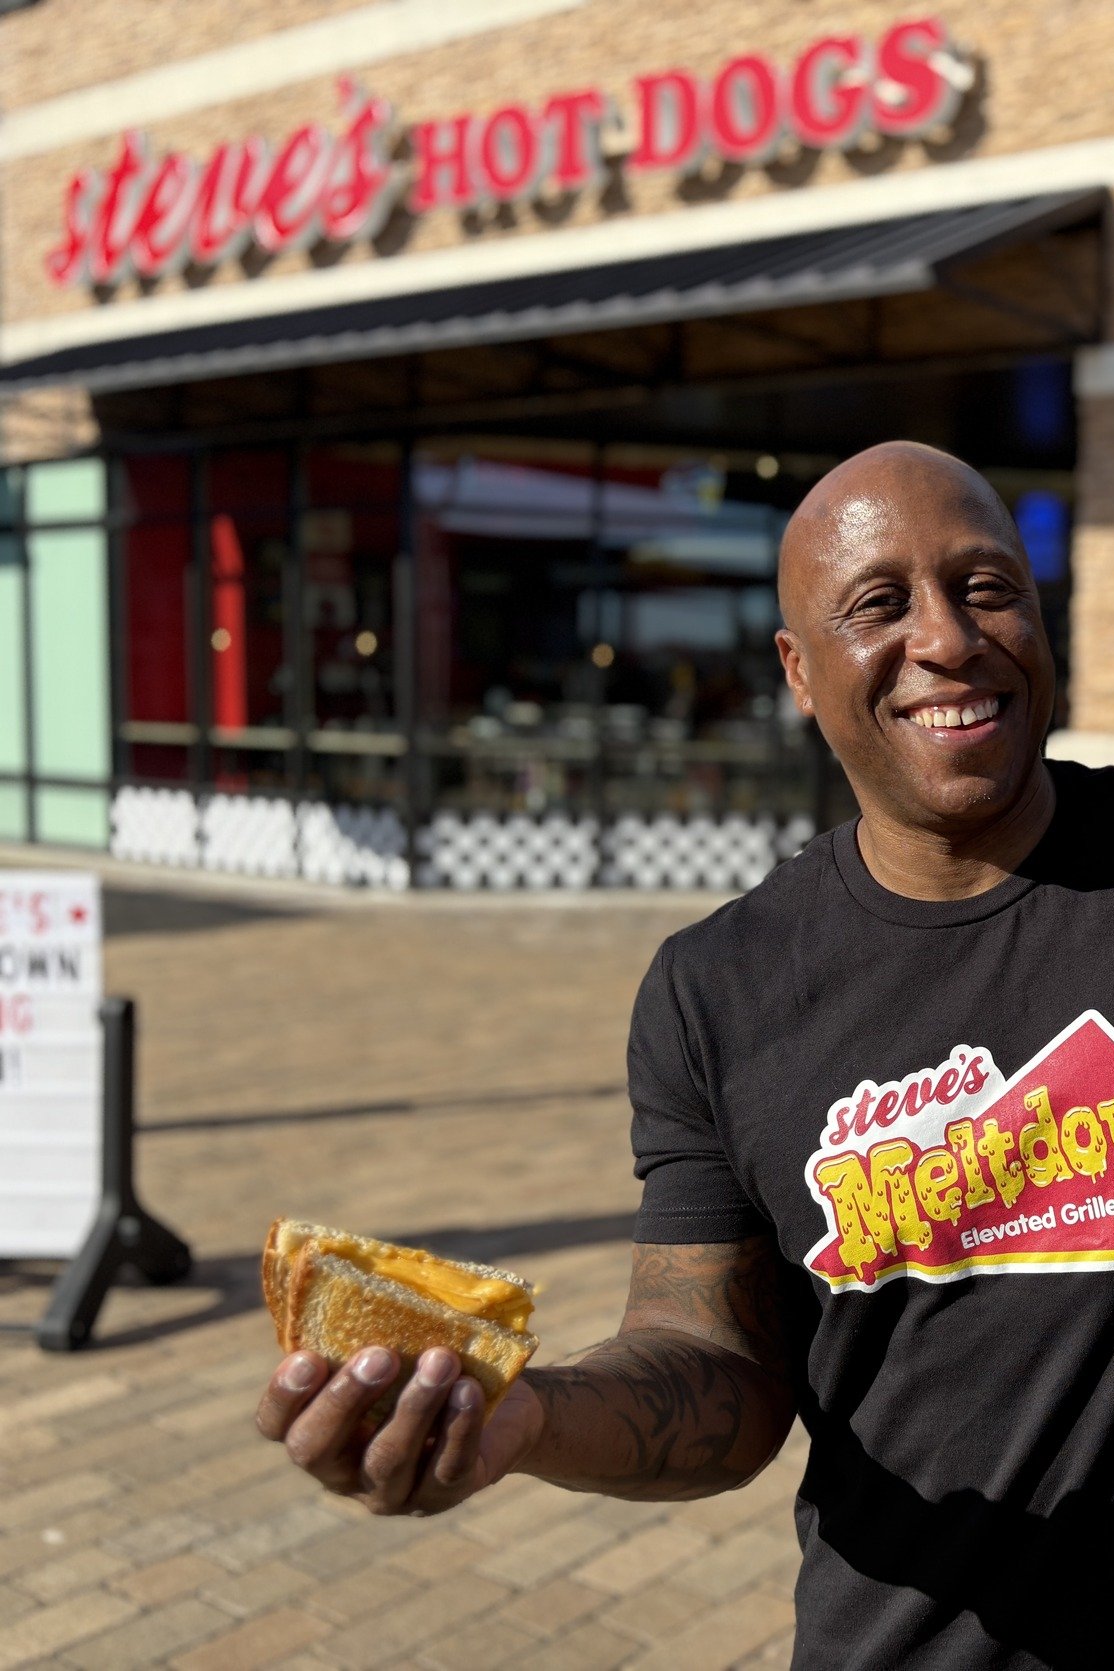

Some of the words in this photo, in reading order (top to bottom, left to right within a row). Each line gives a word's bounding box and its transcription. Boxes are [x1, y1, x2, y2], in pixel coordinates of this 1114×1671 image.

[412, 92, 602, 212] HOT
[633, 20, 946, 170] DOGS
[829, 1053, 989, 1146] steve's
[960, 1206, 1058, 1250] Elevated
